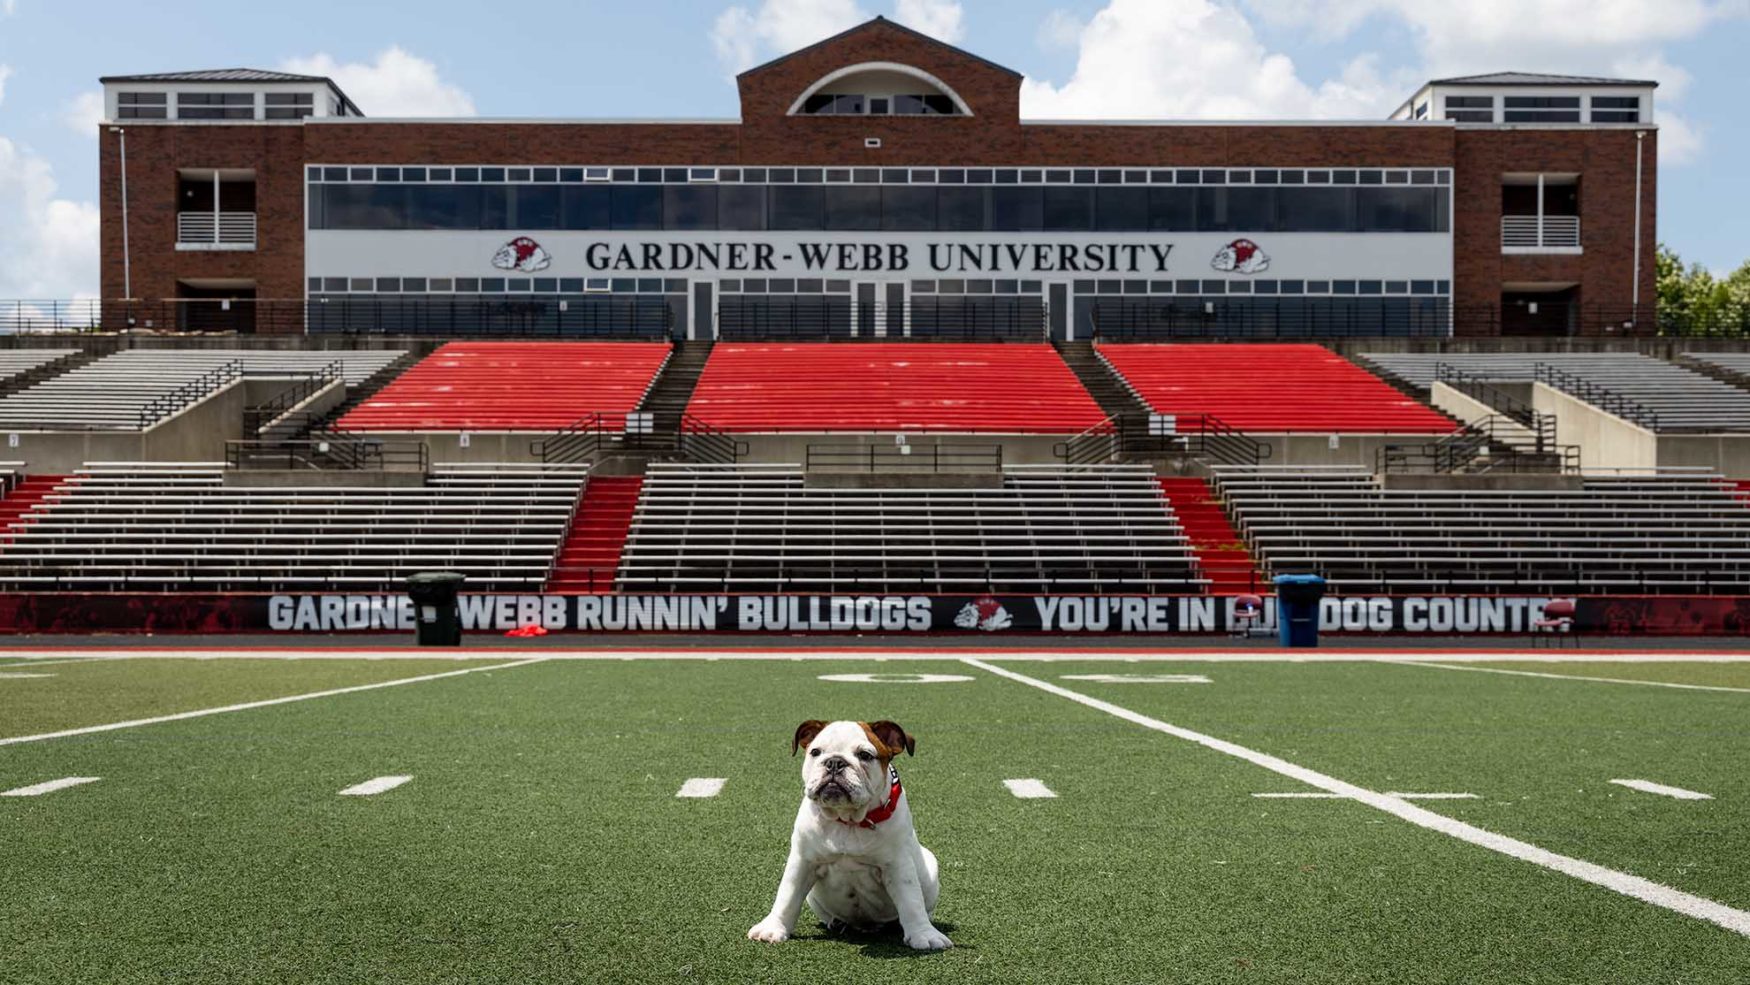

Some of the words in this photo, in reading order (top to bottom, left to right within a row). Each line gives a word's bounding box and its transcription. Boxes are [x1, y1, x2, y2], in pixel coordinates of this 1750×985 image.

[586, 242, 909, 271] GARDNER-WEBB
[927, 243, 1174, 271] UNIVERSITY
[577, 596, 728, 630] RUNNIN'
[738, 596, 932, 630] BULLDOGS
[1034, 597, 1168, 631] YOU'RE
[1178, 597, 1215, 631] IN
